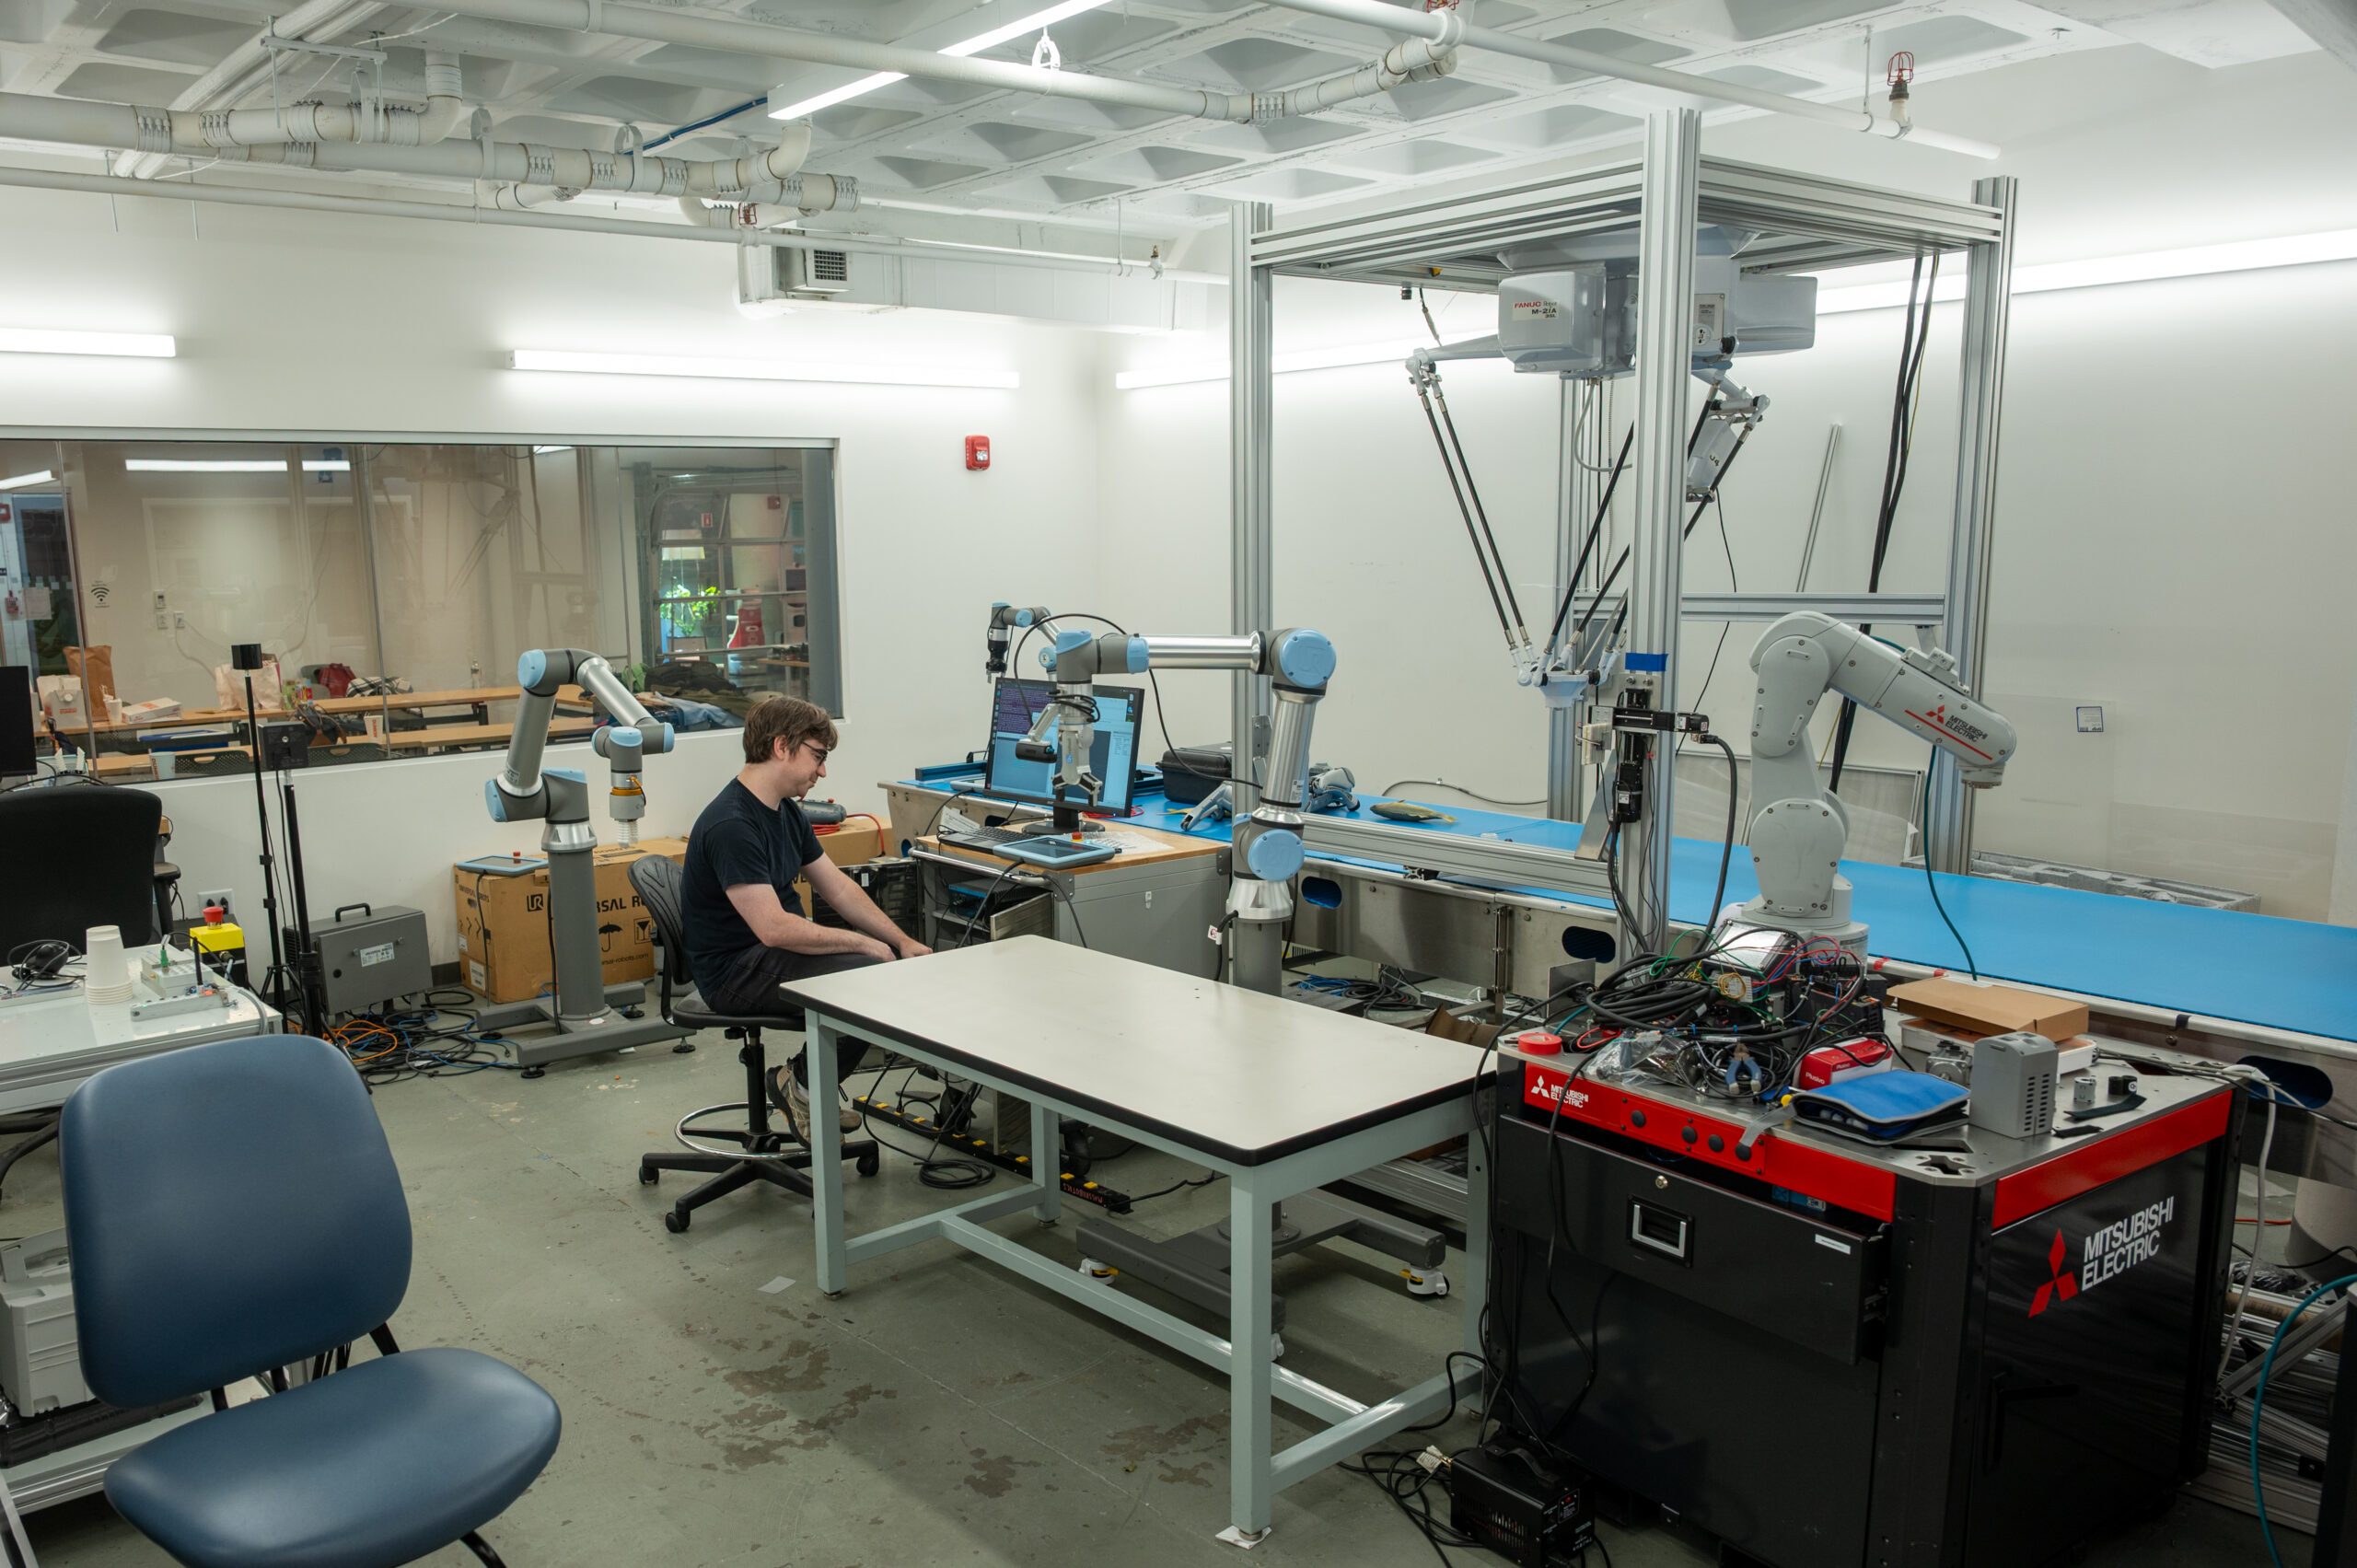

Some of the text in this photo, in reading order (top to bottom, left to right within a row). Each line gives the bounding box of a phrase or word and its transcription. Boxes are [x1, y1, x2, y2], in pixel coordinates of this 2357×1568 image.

[1945, 720, 1979, 742] ELECTRIC
[1949, 714, 1988, 739] MITSUBISHI
[601, 953, 649, 965] rsal-robots.com
[1805, 1072, 1825, 1085] Plusivo
[1550, 1084, 1588, 1103] MITUBISHI
[2084, 1196, 2175, 1263] MITSUBISHI
[2082, 1230, 2161, 1291] ELECTRIC
